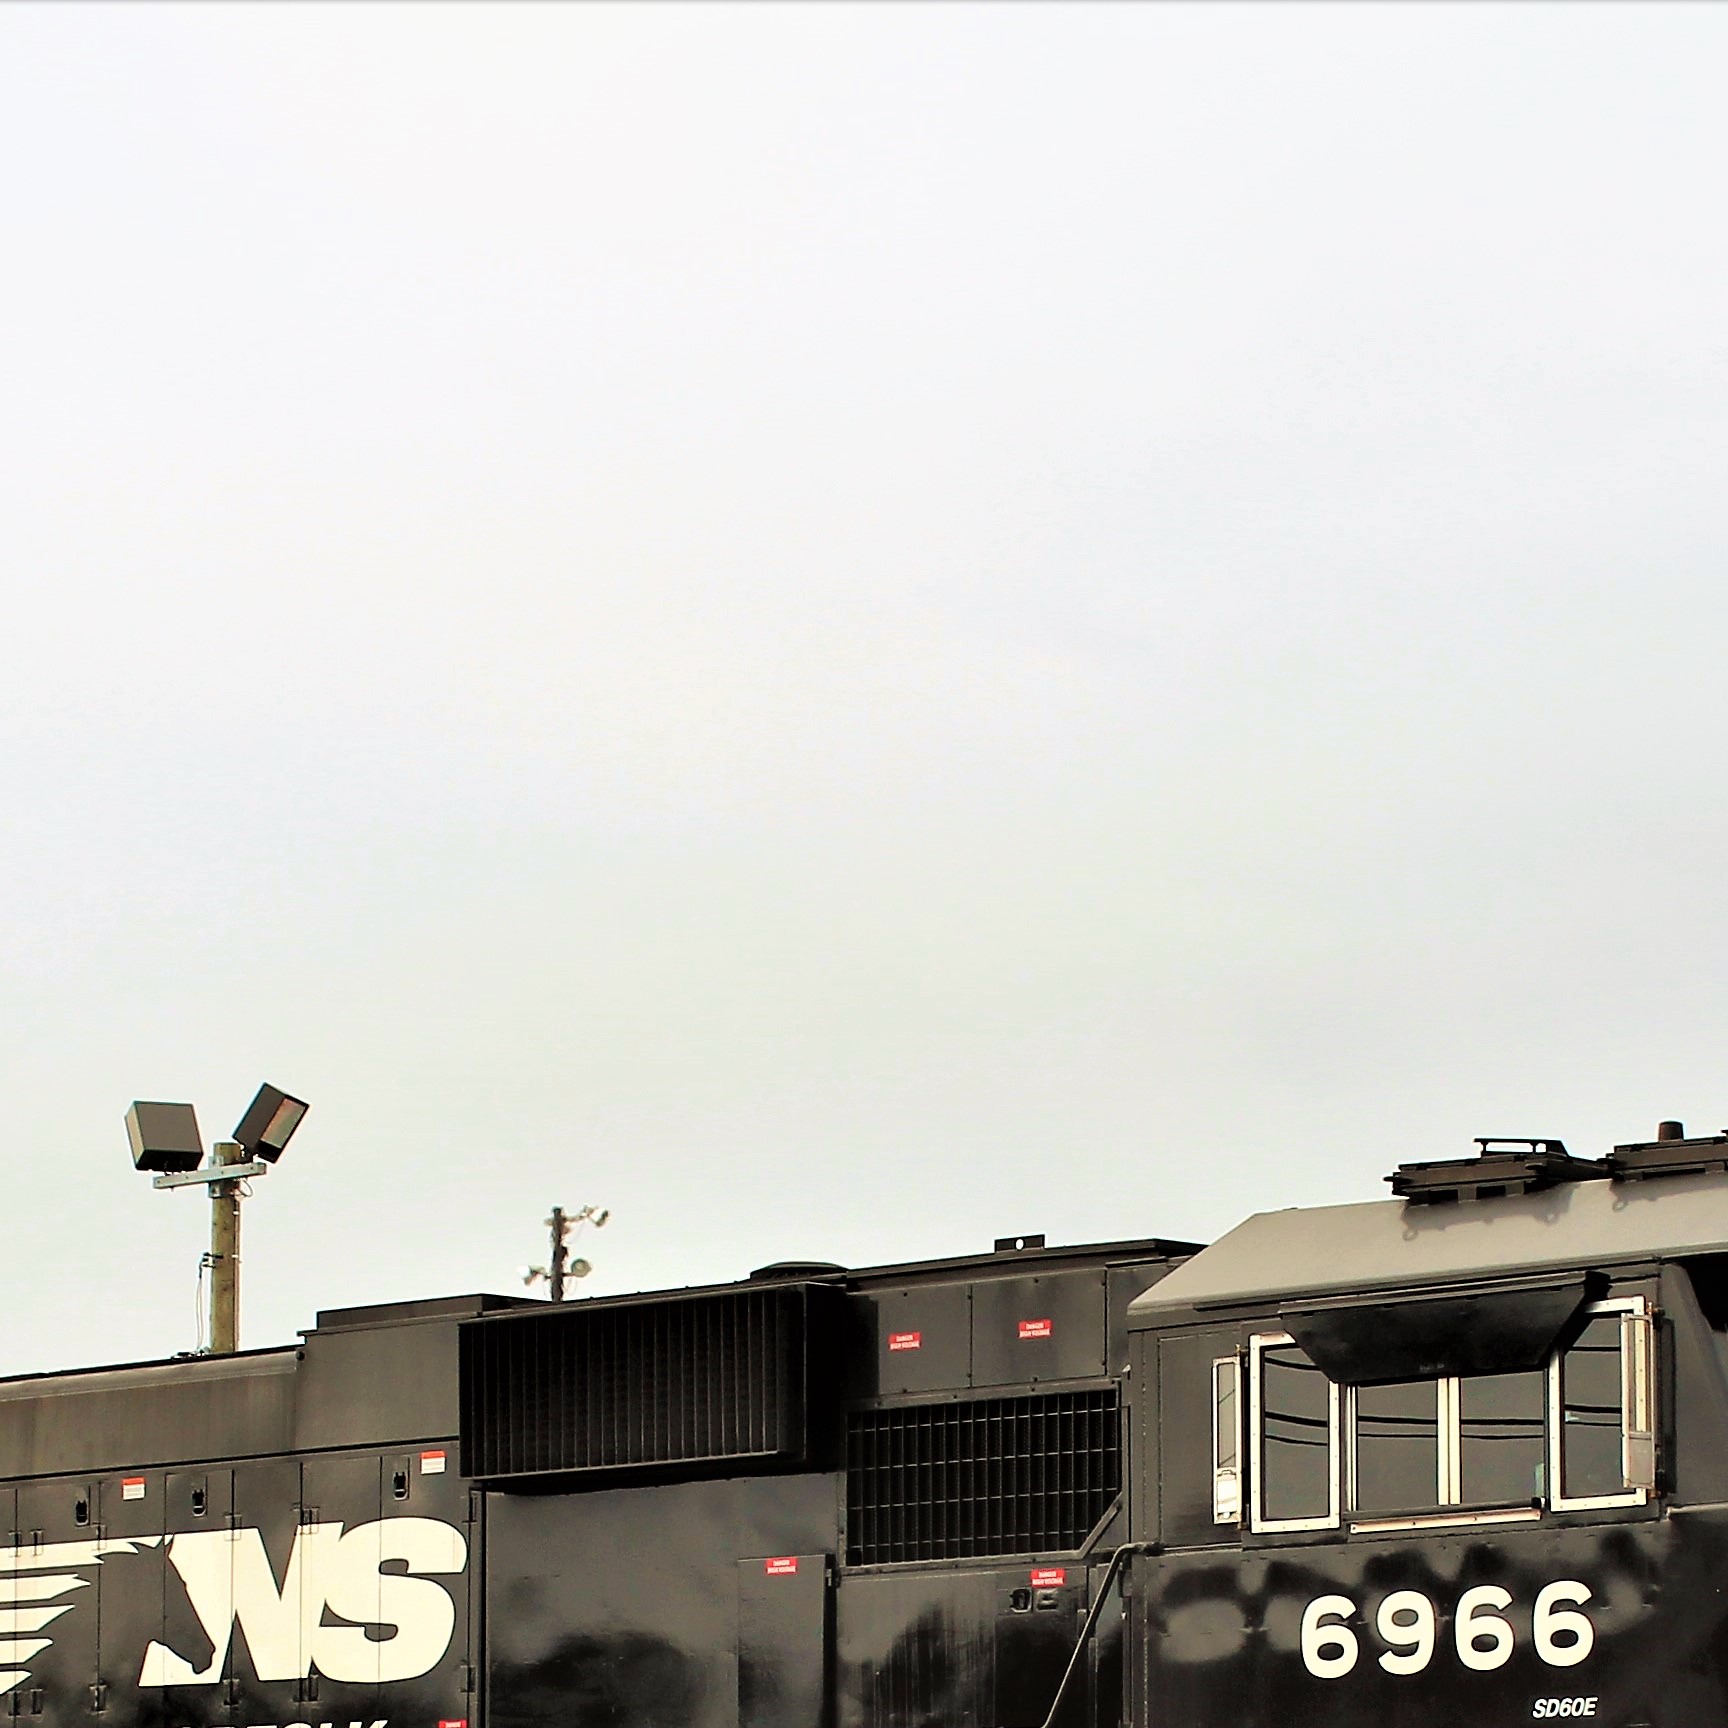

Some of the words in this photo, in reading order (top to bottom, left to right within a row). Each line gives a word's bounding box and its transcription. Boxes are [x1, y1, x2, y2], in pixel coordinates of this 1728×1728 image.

[138, 1516, 468, 1687] NS
[1301, 1580, 1595, 1679] 6966
[1532, 1697, 1598, 1718] SD60E
